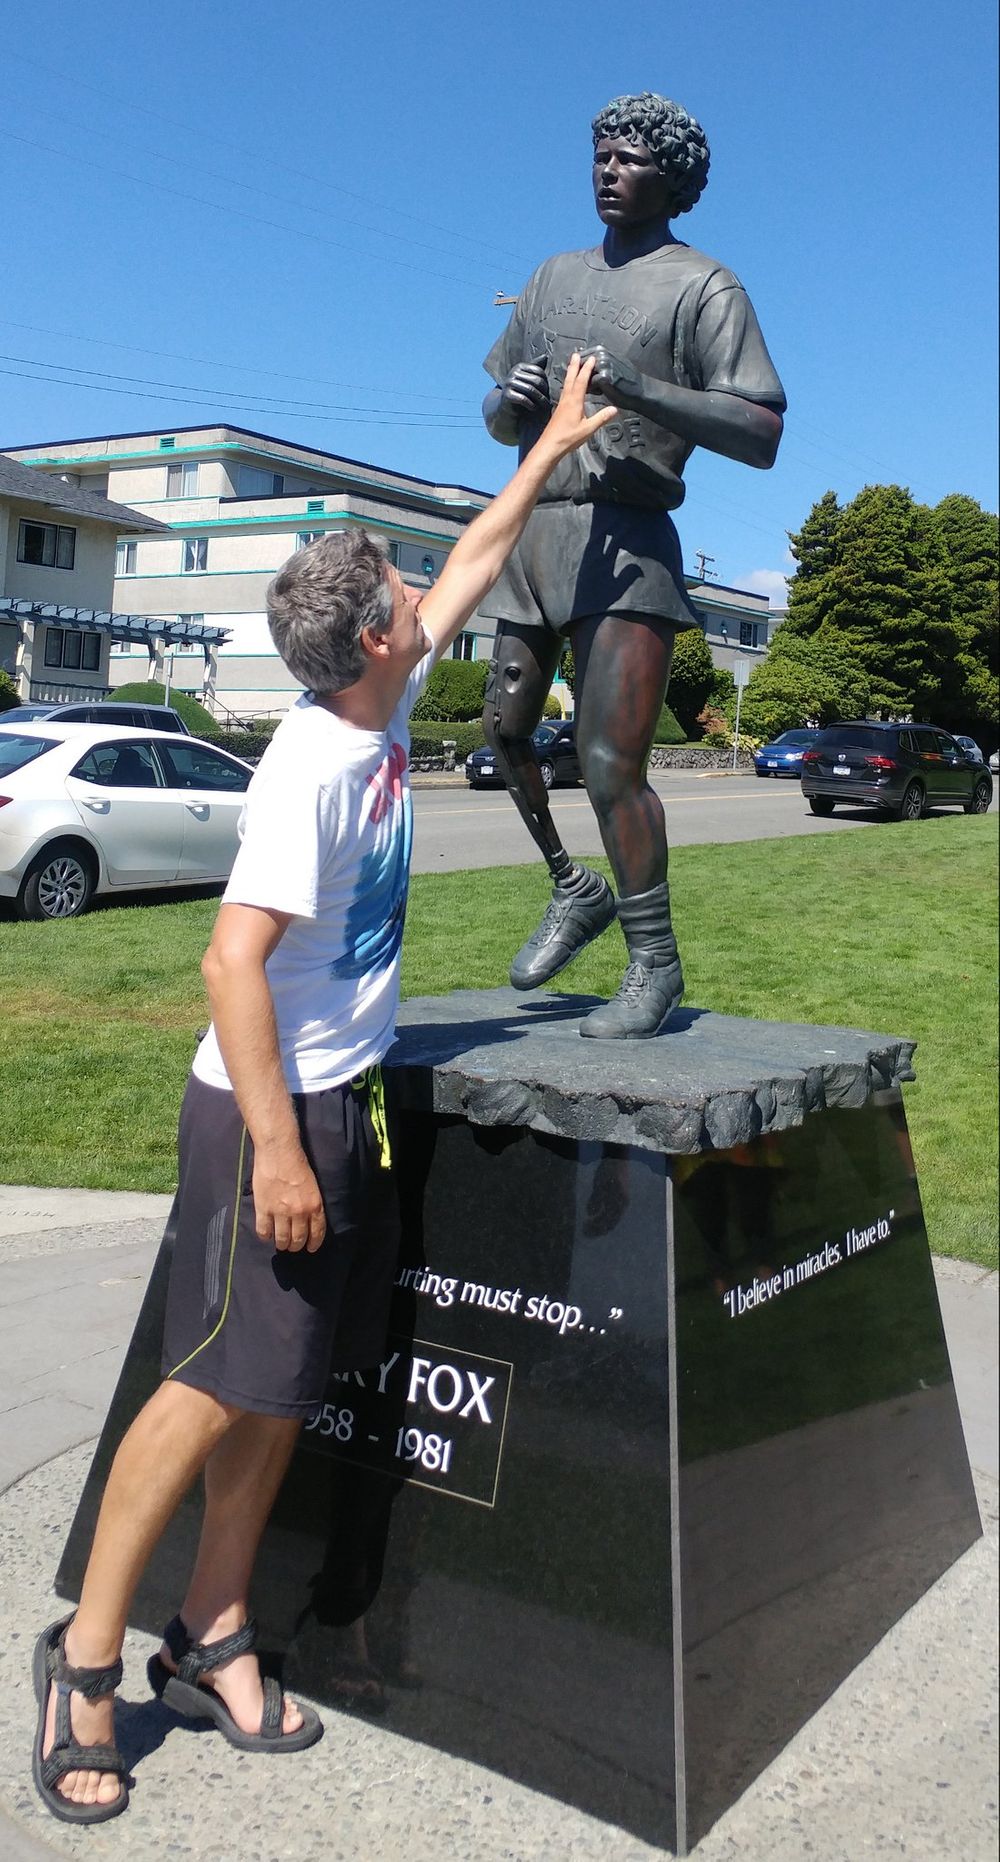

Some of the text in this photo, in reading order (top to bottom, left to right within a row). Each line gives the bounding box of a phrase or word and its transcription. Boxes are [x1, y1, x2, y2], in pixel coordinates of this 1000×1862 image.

[528, 293, 658, 348] ARATHON
[393, 1266, 457, 1306] urting
[460, 1281, 522, 1314] must
[738, 1276, 781, 1314] believe
[783, 1265, 795, 1290] in
[796, 1241, 843, 1283] miracles.
[846, 1231, 851, 1256] I
[852, 1228, 876, 1253] have
[407, 1357, 495, 1423] FOX
[304, 1404, 354, 1441] 58
[395, 1427, 453, 1473] 1981
